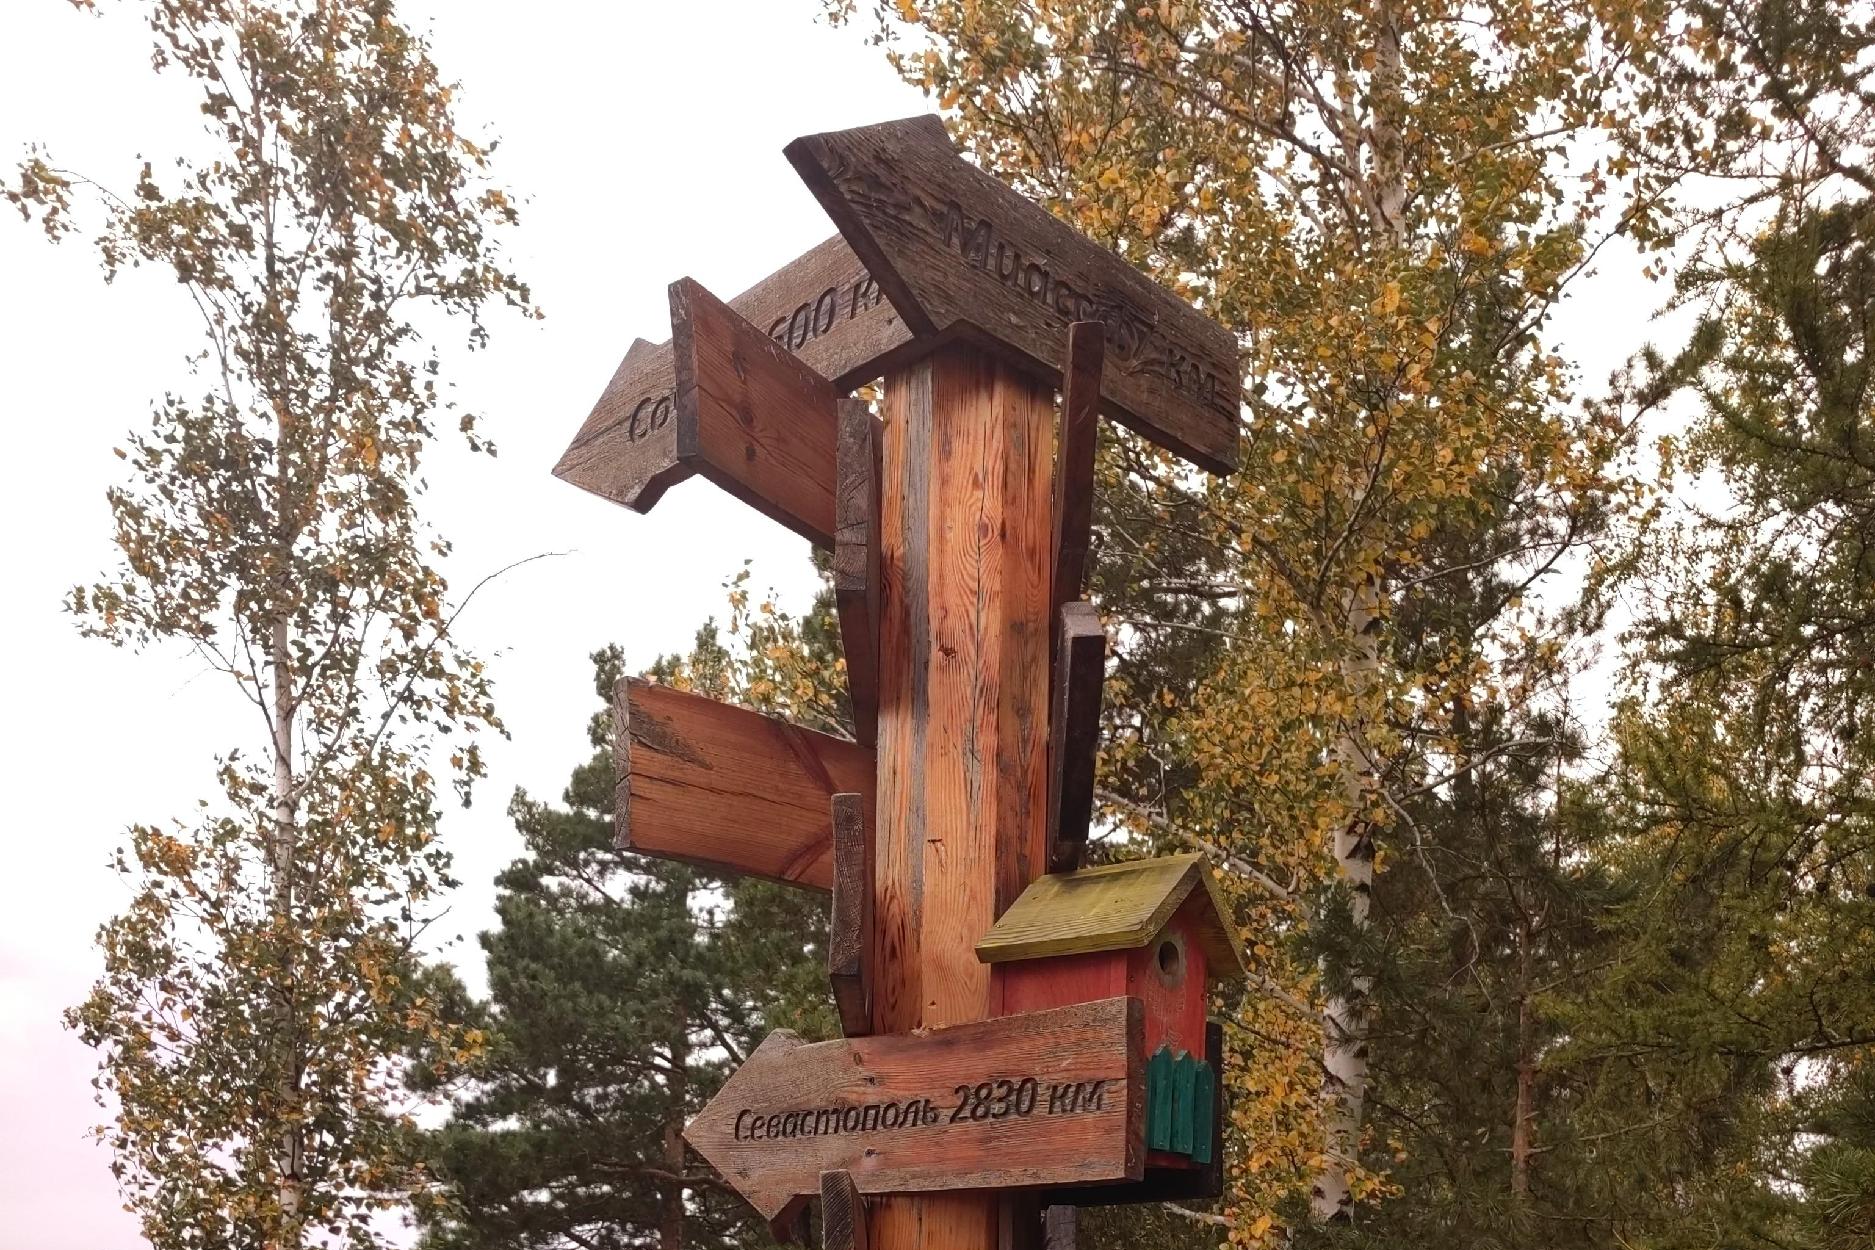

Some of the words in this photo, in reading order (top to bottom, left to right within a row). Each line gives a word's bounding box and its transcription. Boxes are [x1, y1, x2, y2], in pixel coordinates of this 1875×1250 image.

[1166, 347, 1216, 402] км
[629, 392, 677, 442] Со
[734, 1099, 940, 1141] Севастополь
[950, 1077, 1039, 1124] 2830
[1048, 1080, 1105, 1115] км
